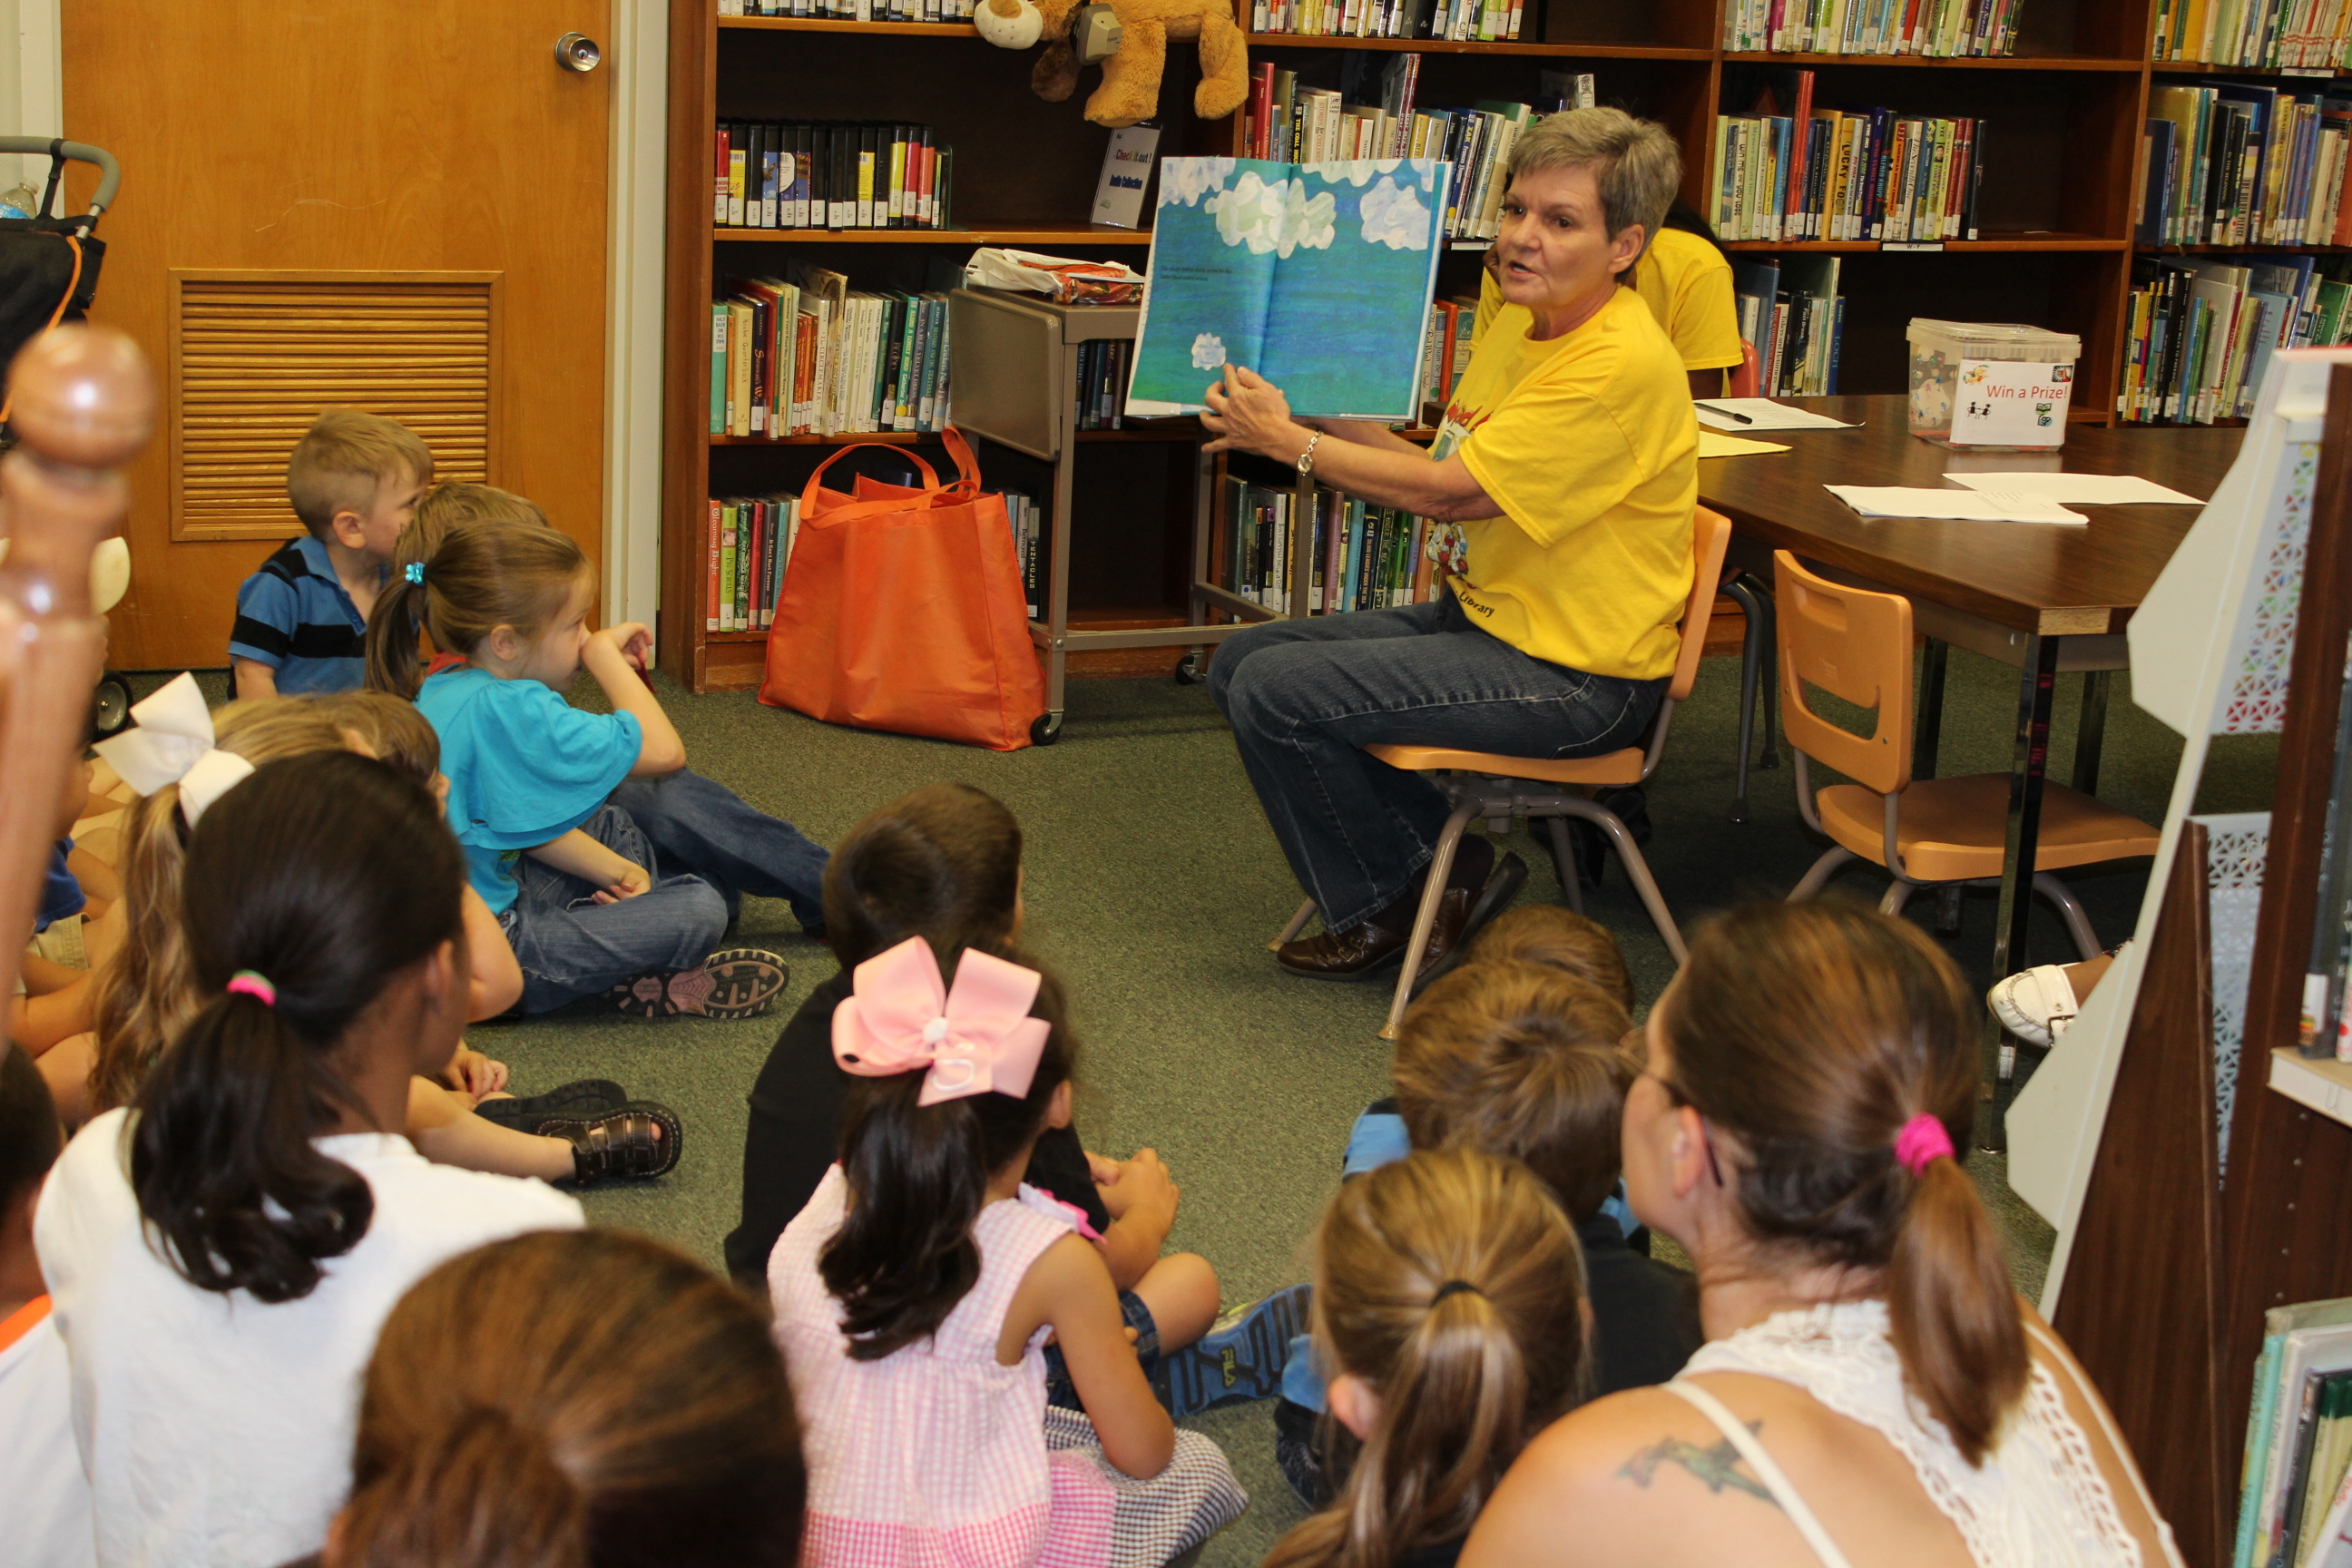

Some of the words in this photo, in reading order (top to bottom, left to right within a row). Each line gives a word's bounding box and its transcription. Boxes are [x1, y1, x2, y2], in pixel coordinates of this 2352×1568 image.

[1465, 126, 1474, 142] ZAK
[1460, 145, 1469, 163] Frances
[1839, 143, 1851, 179] LUCKY
[1455, 164, 1465, 183] Thomas
[2242, 180, 2250, 191] THE
[2239, 192, 2249, 214] GOLDEN
[2235, 217, 2246, 237] FLEECE
[1832, 336, 1840, 368] LOCH
[754, 349, 764, 385] Saraswati's
[816, 347, 825, 401] CIRCLEMAKER
[914, 352, 922, 377] VELVET
[1773, 351, 1782, 384] Returners
[753, 386, 763, 402] Way
[899, 374, 907, 397] Catherine
[1986, 385, 2014, 398] Win
[2018, 389, 2025, 398] a
[2031, 386, 2068, 399] Prize!
[710, 507, 720, 548] Gleaming
[710, 550, 719, 576] Bright
[726, 557, 734, 568] PIG
[725, 570, 733, 593] SCROLLS
[1459, 590, 1495, 618] Library
